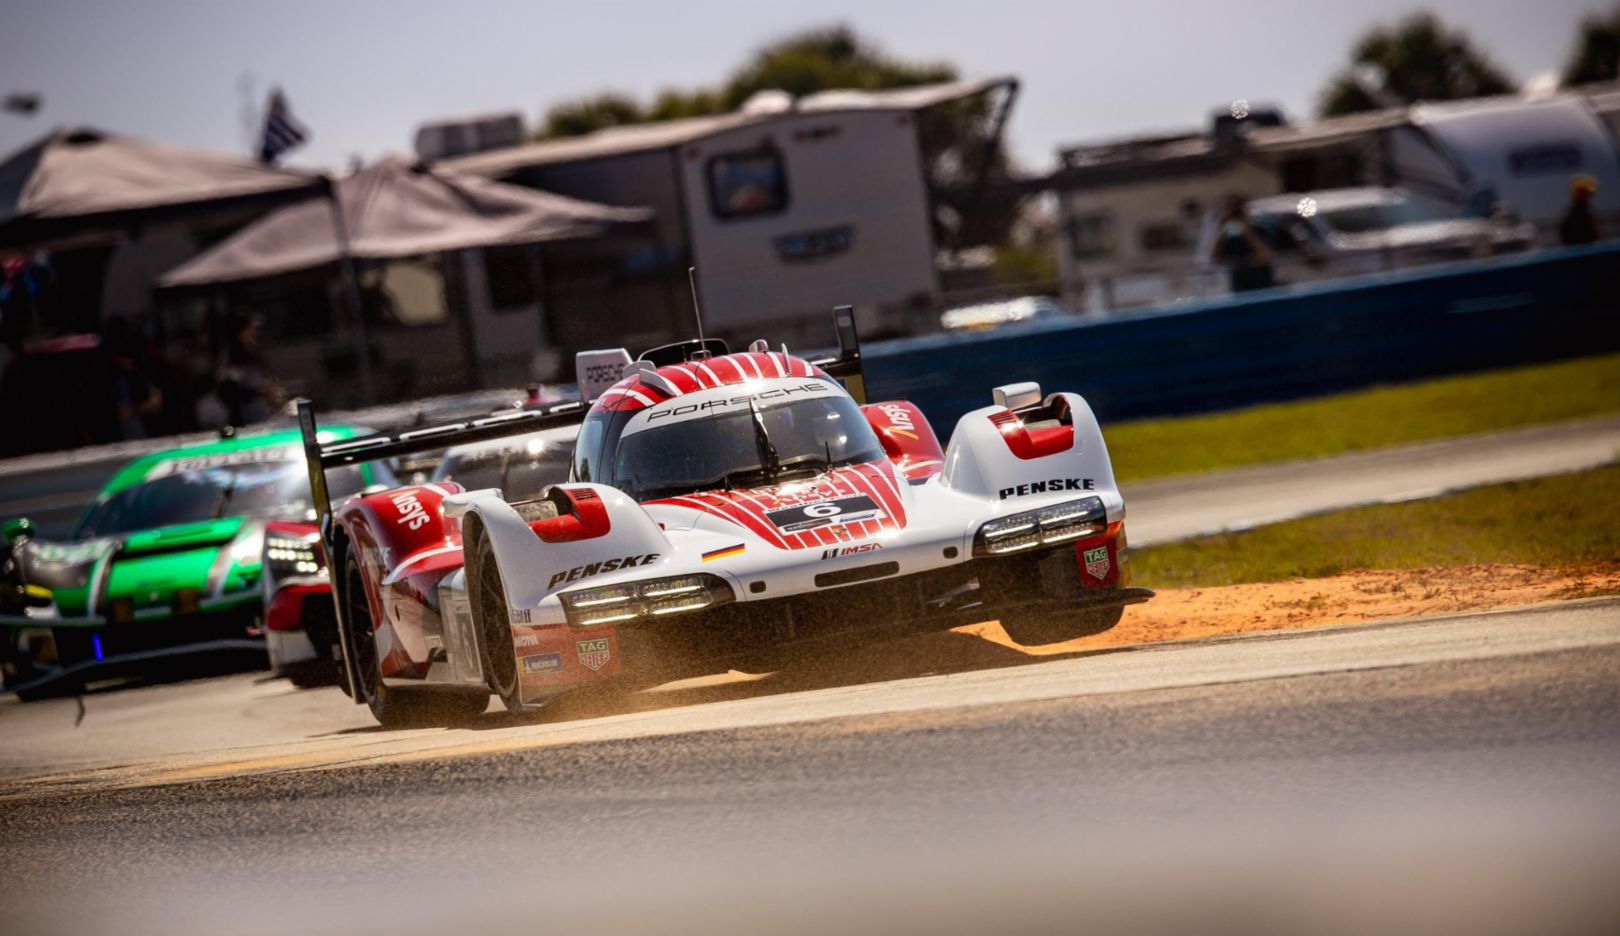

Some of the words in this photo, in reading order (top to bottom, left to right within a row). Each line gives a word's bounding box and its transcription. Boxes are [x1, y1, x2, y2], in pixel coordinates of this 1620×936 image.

[647, 383, 828, 422] PORSCHE
[999, 478, 1095, 500] PENSKE
[803, 503, 842, 518] 6
[841, 543, 882, 556] IMSA
[1086, 549, 1107, 562] TAG
[546, 553, 661, 590] PENSKE
[579, 641, 606, 653] TAG
